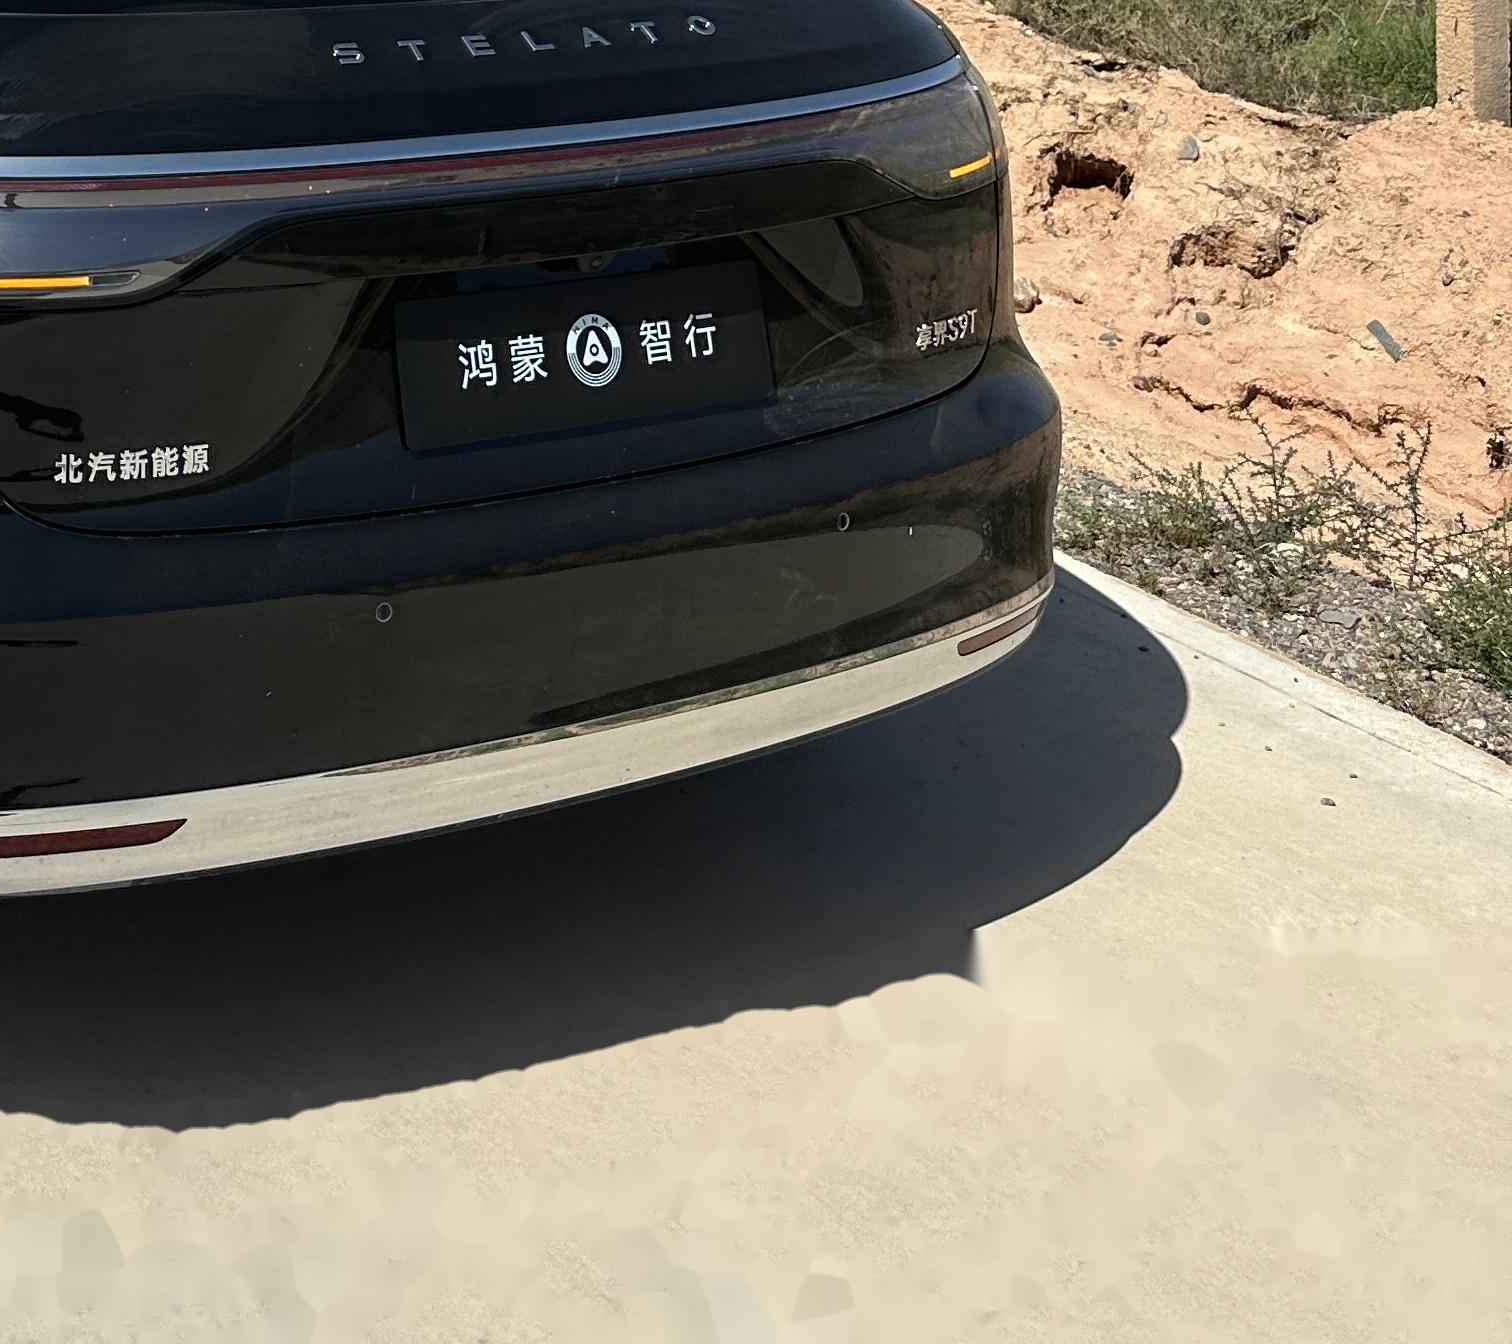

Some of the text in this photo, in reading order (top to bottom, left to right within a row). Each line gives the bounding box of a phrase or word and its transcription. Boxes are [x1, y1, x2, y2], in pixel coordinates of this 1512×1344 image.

[331, 14, 717, 65] STELATO
[457, 313, 717, 390] 鸿蒙 智行
[53, 443, 210, 484] 北汽新能源
